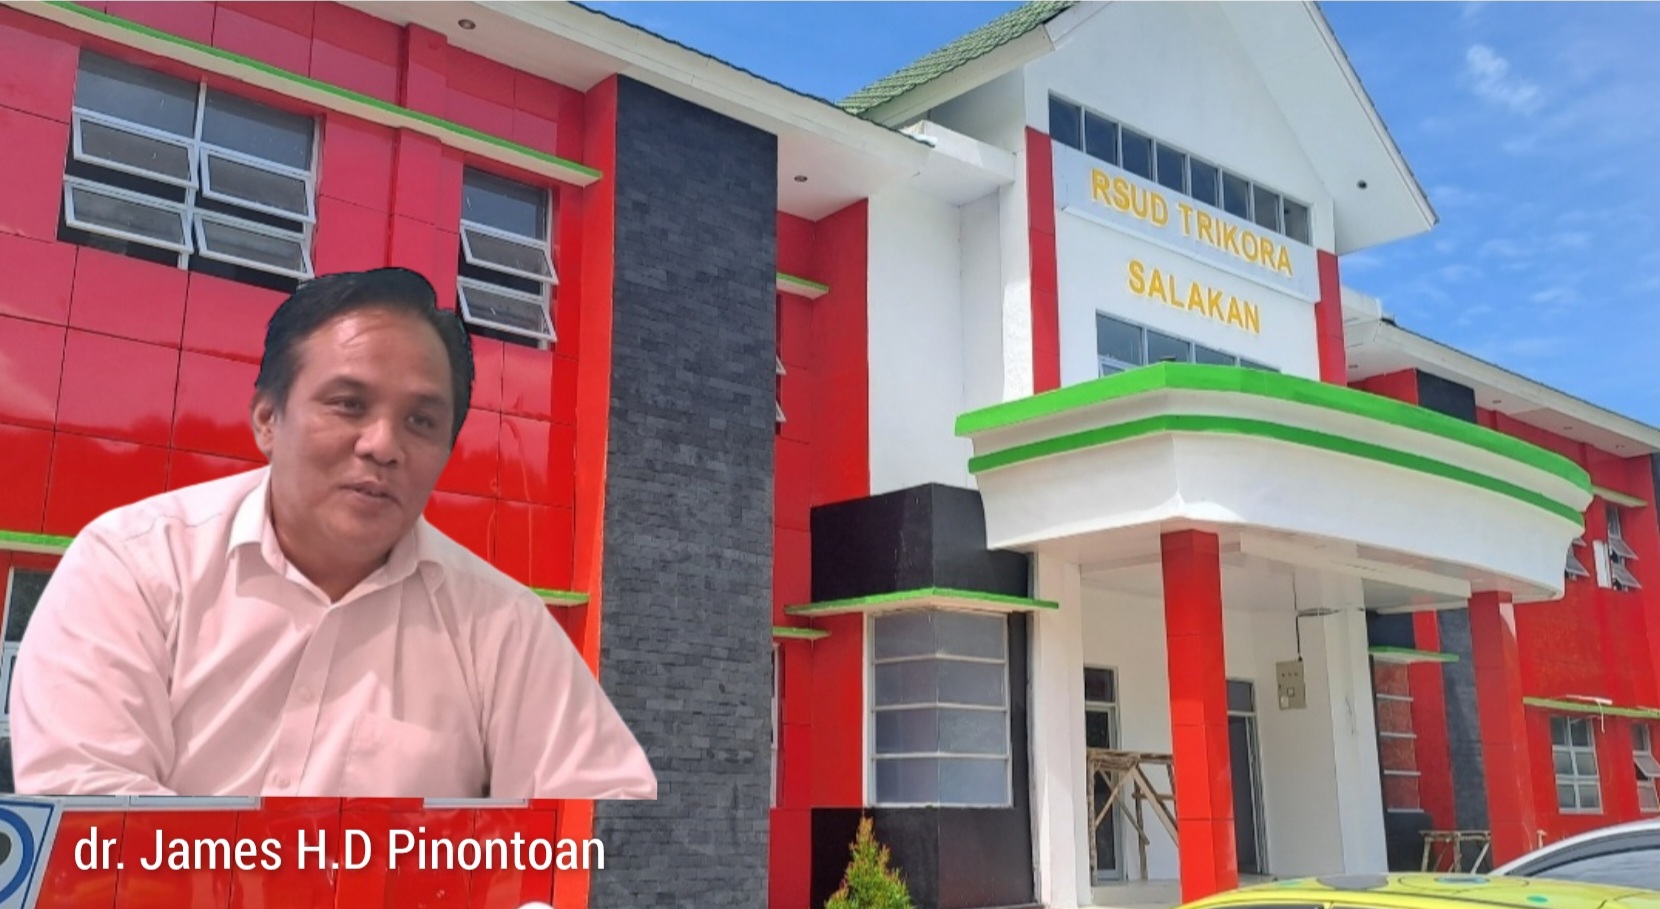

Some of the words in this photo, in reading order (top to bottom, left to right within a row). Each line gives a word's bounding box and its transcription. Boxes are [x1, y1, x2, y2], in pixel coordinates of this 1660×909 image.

[1091, 168, 1168, 226] RSUD
[1178, 202, 1293, 276] TRIKORA
[1128, 259, 1260, 334] SALAKAN
